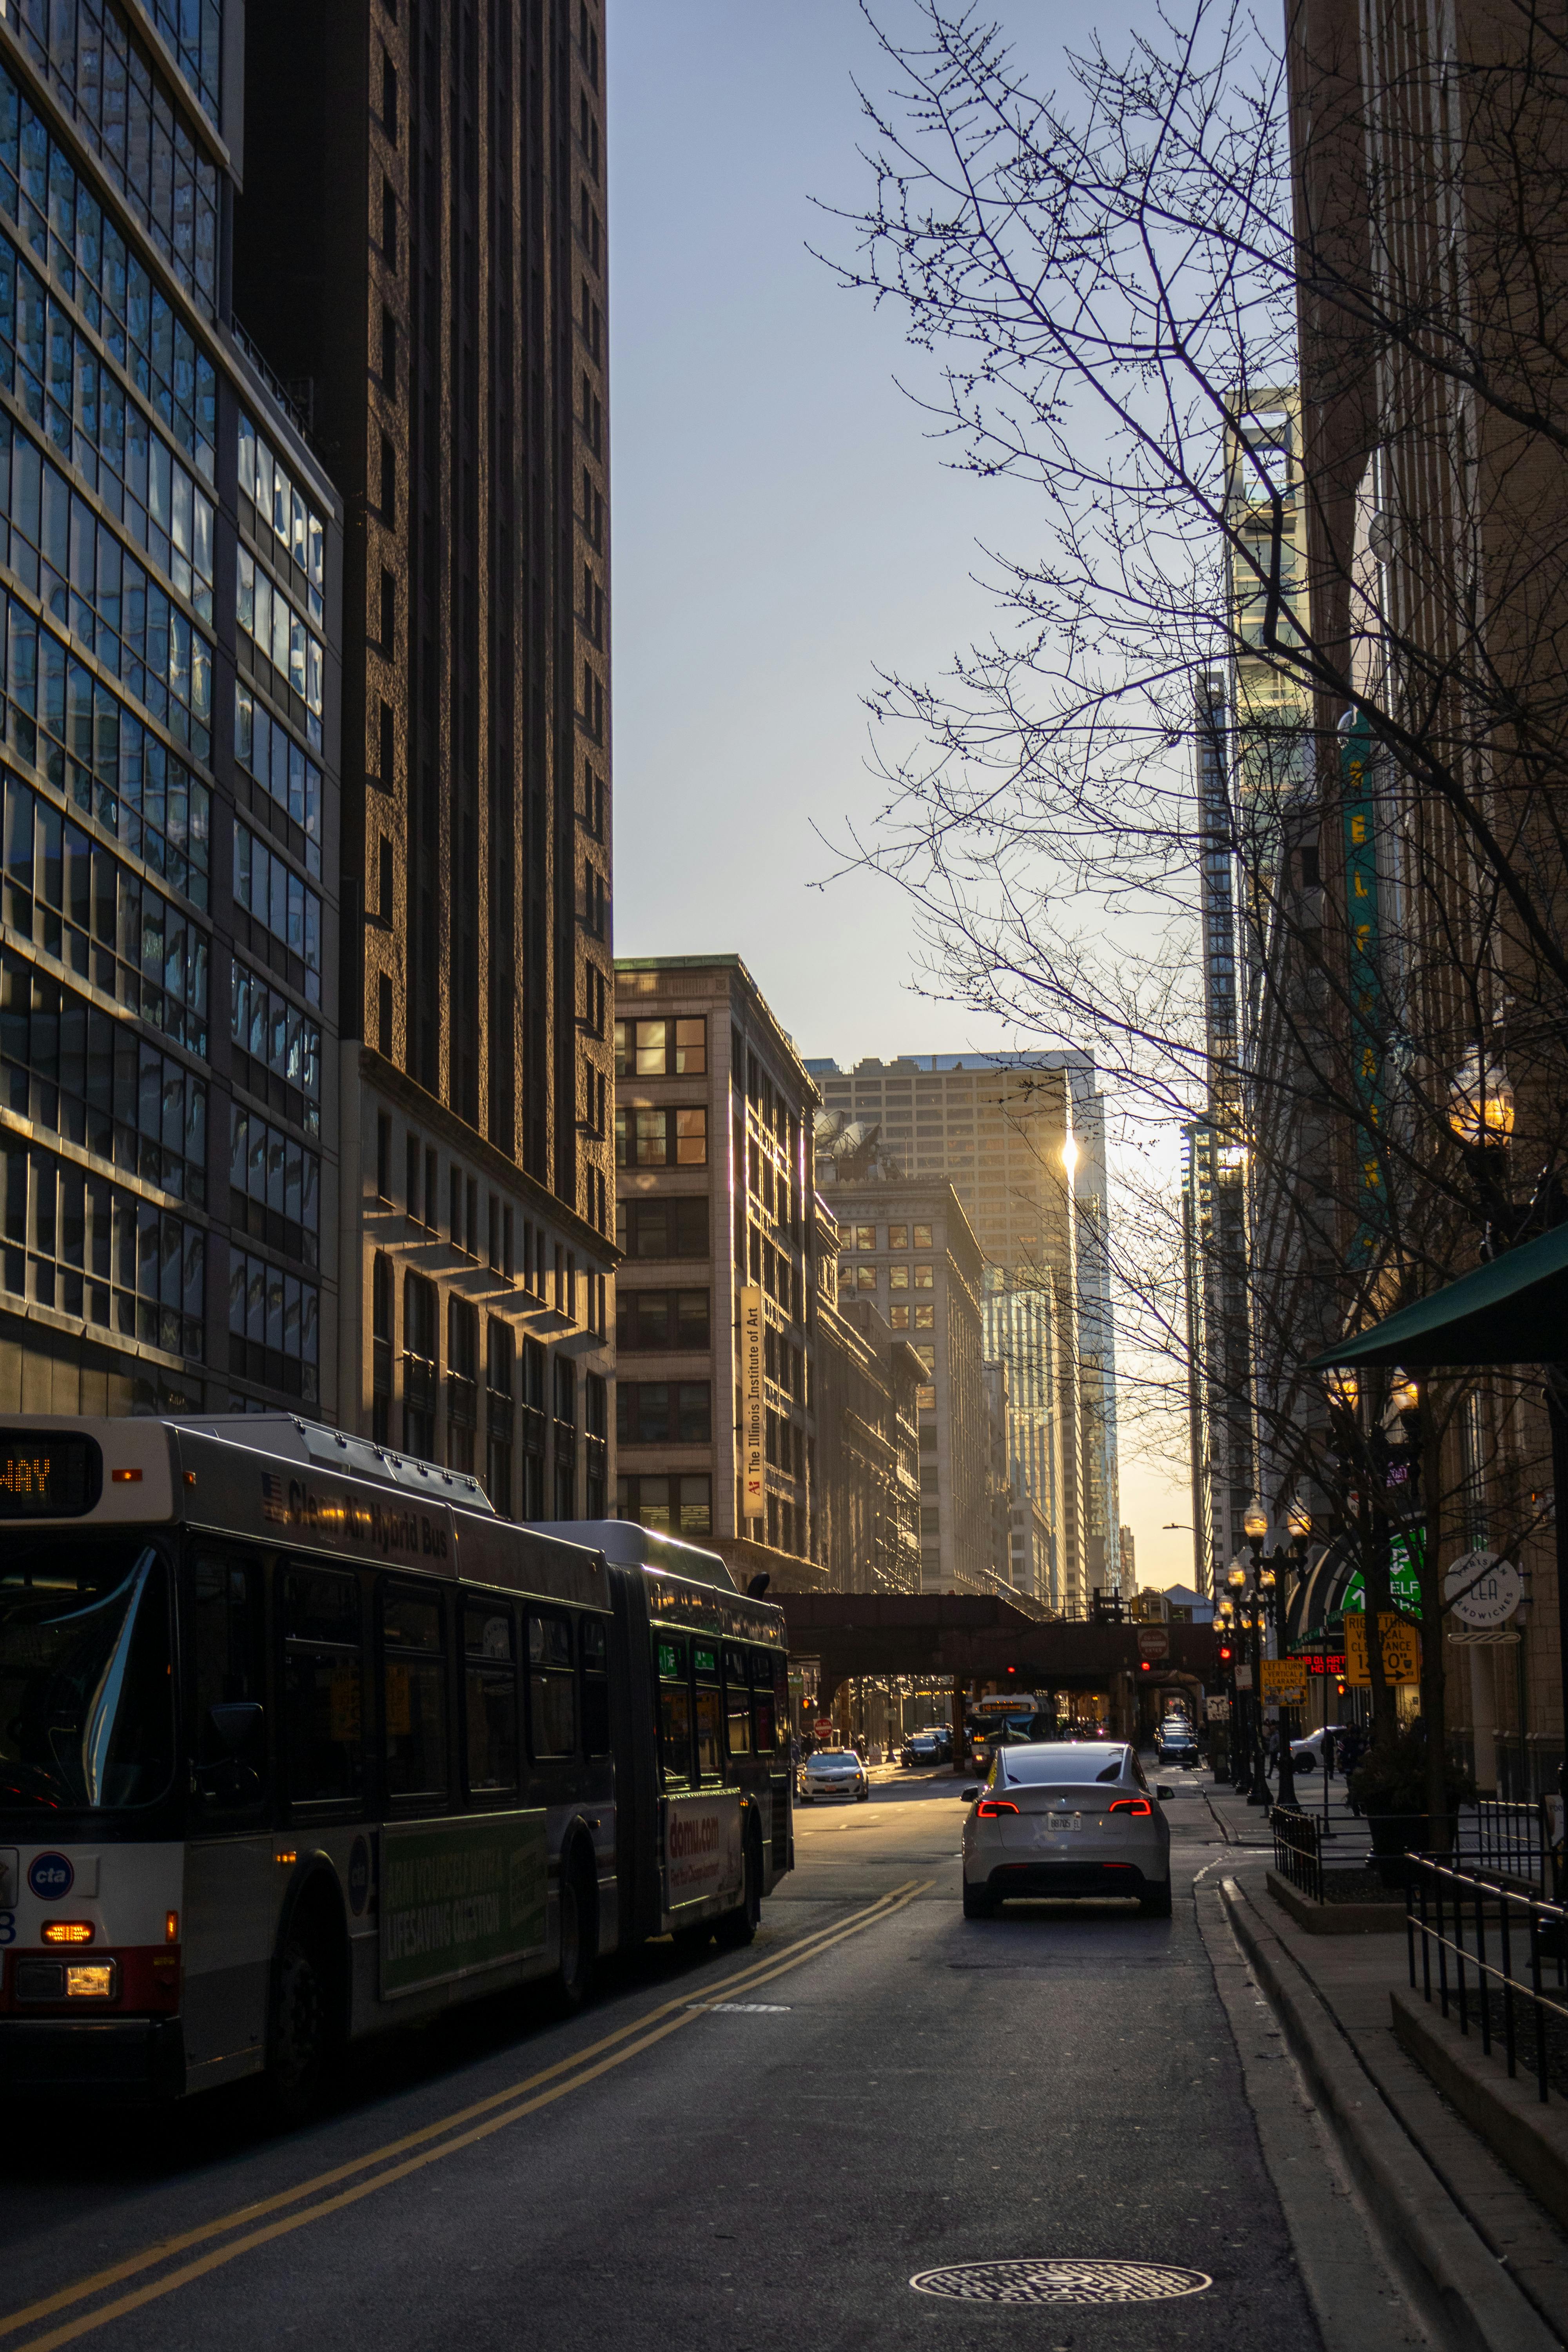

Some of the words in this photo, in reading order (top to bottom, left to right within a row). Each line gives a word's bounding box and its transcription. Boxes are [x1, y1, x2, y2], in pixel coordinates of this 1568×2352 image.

[747, 1308, 758, 1326] Art
[749, 1329, 759, 1341] of
[748, 1346, 759, 1399] Institute
[748, 1404, 760, 1447] Illinois
[749, 1451, 760, 1474] The
[289, 1478, 339, 1532] Clean
[345, 1495, 365, 1539] Air
[370, 1502, 418, 1553] Hybrid
[422, 1516, 447, 1558] Bus
[1390, 1581, 1420, 1595] ELF
[1455, 1592, 1513, 1619] ANDWICHES
[1263, 1662, 1281, 1671] LEFT
[35, 1867, 67, 1884] cta
[417, 1852, 468, 1902] YOURSELF
[387, 1902, 450, 1960] LIFESAVING
[452, 1891, 500, 1944] QUESTION
